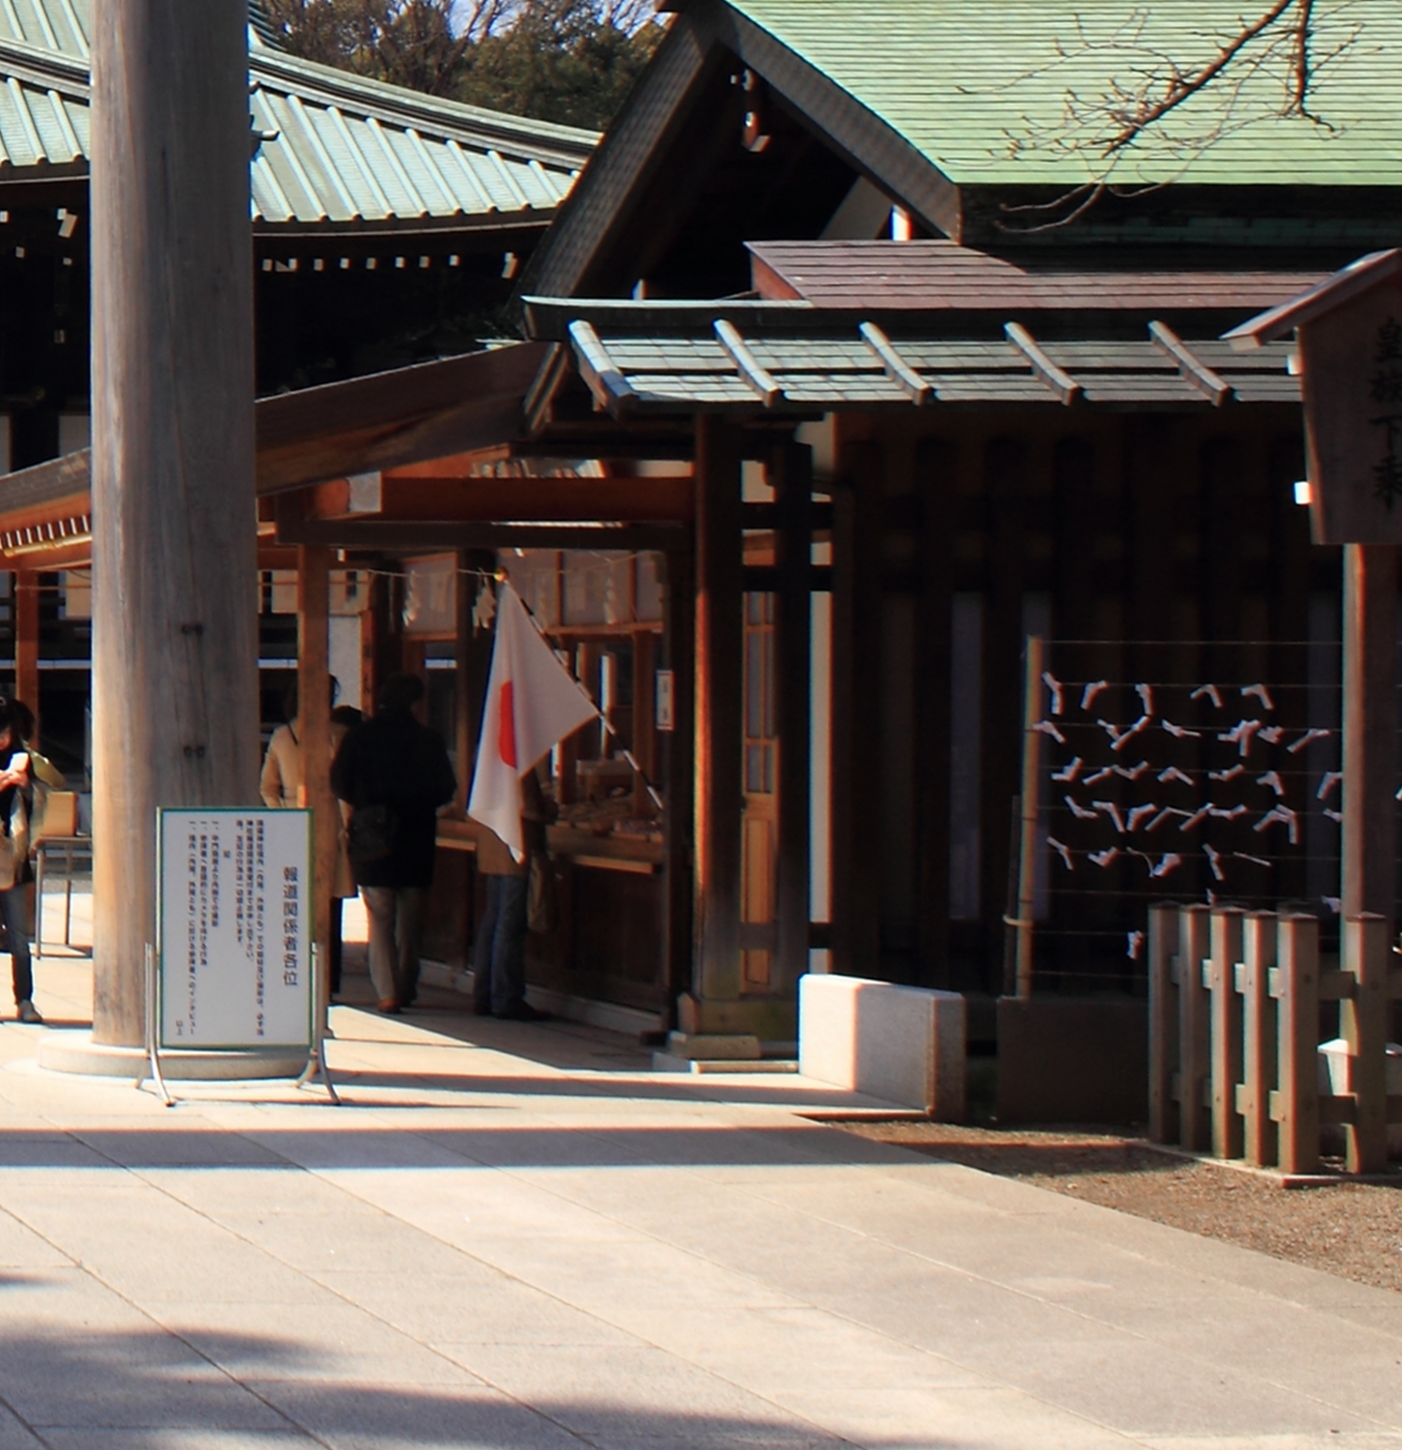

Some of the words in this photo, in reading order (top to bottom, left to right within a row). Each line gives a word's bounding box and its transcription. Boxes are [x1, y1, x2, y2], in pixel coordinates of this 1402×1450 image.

[282, 866, 298, 986] 報道関係者各位
